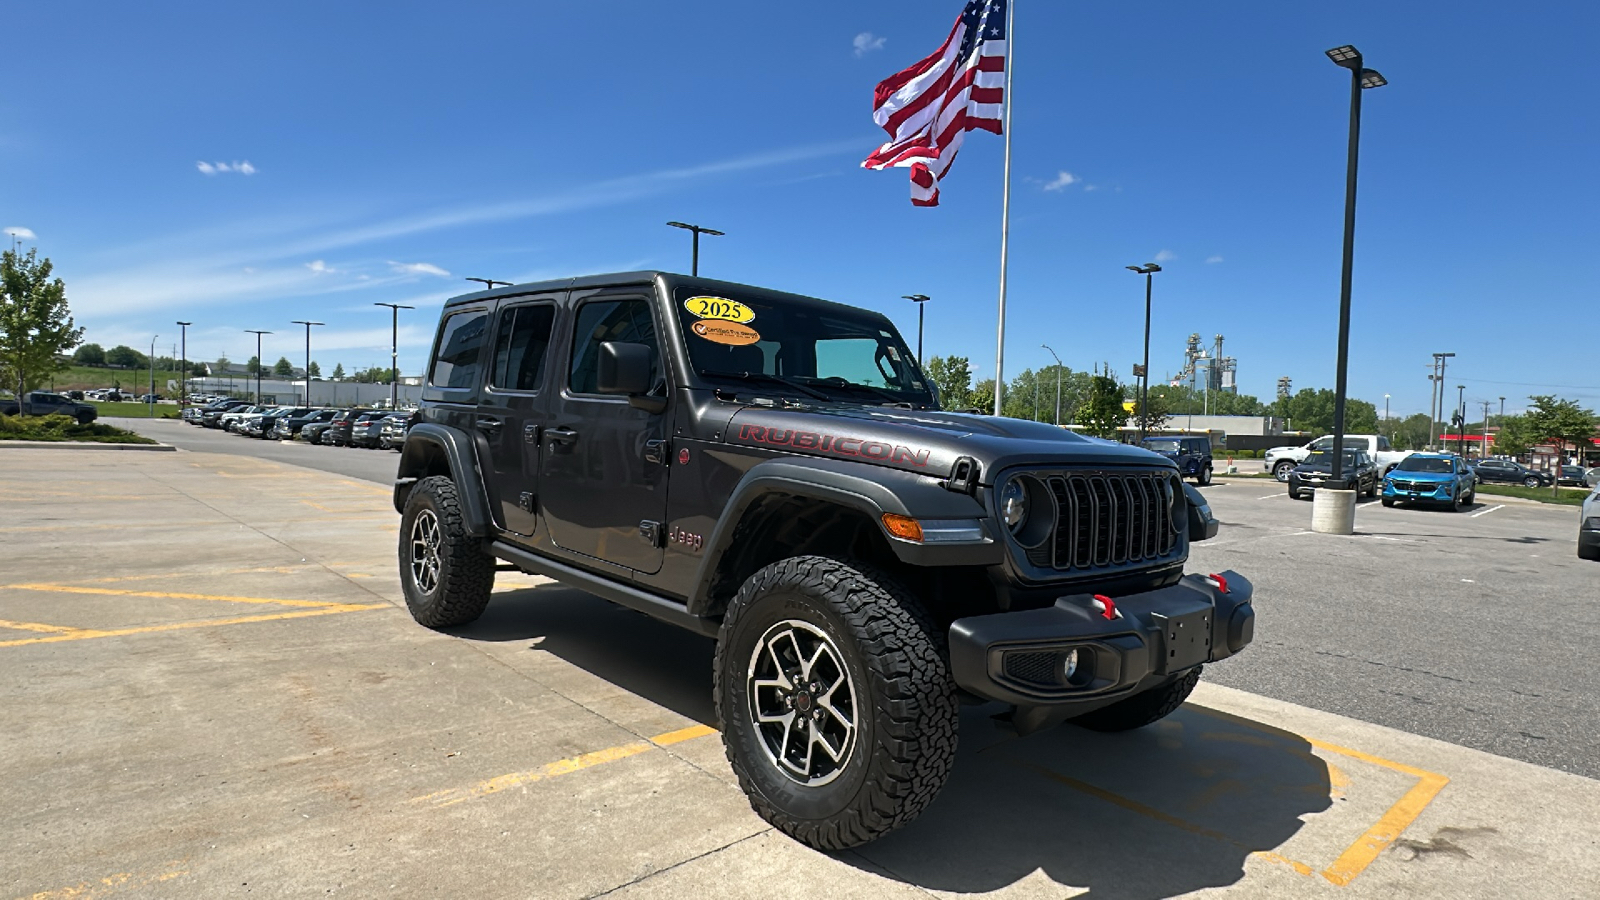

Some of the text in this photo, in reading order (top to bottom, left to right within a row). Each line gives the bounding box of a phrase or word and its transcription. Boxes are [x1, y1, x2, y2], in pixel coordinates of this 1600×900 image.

[699, 300, 741, 319] 2025
[738, 424, 931, 467] RUBICON
[669, 526, 703, 552] Jeep
